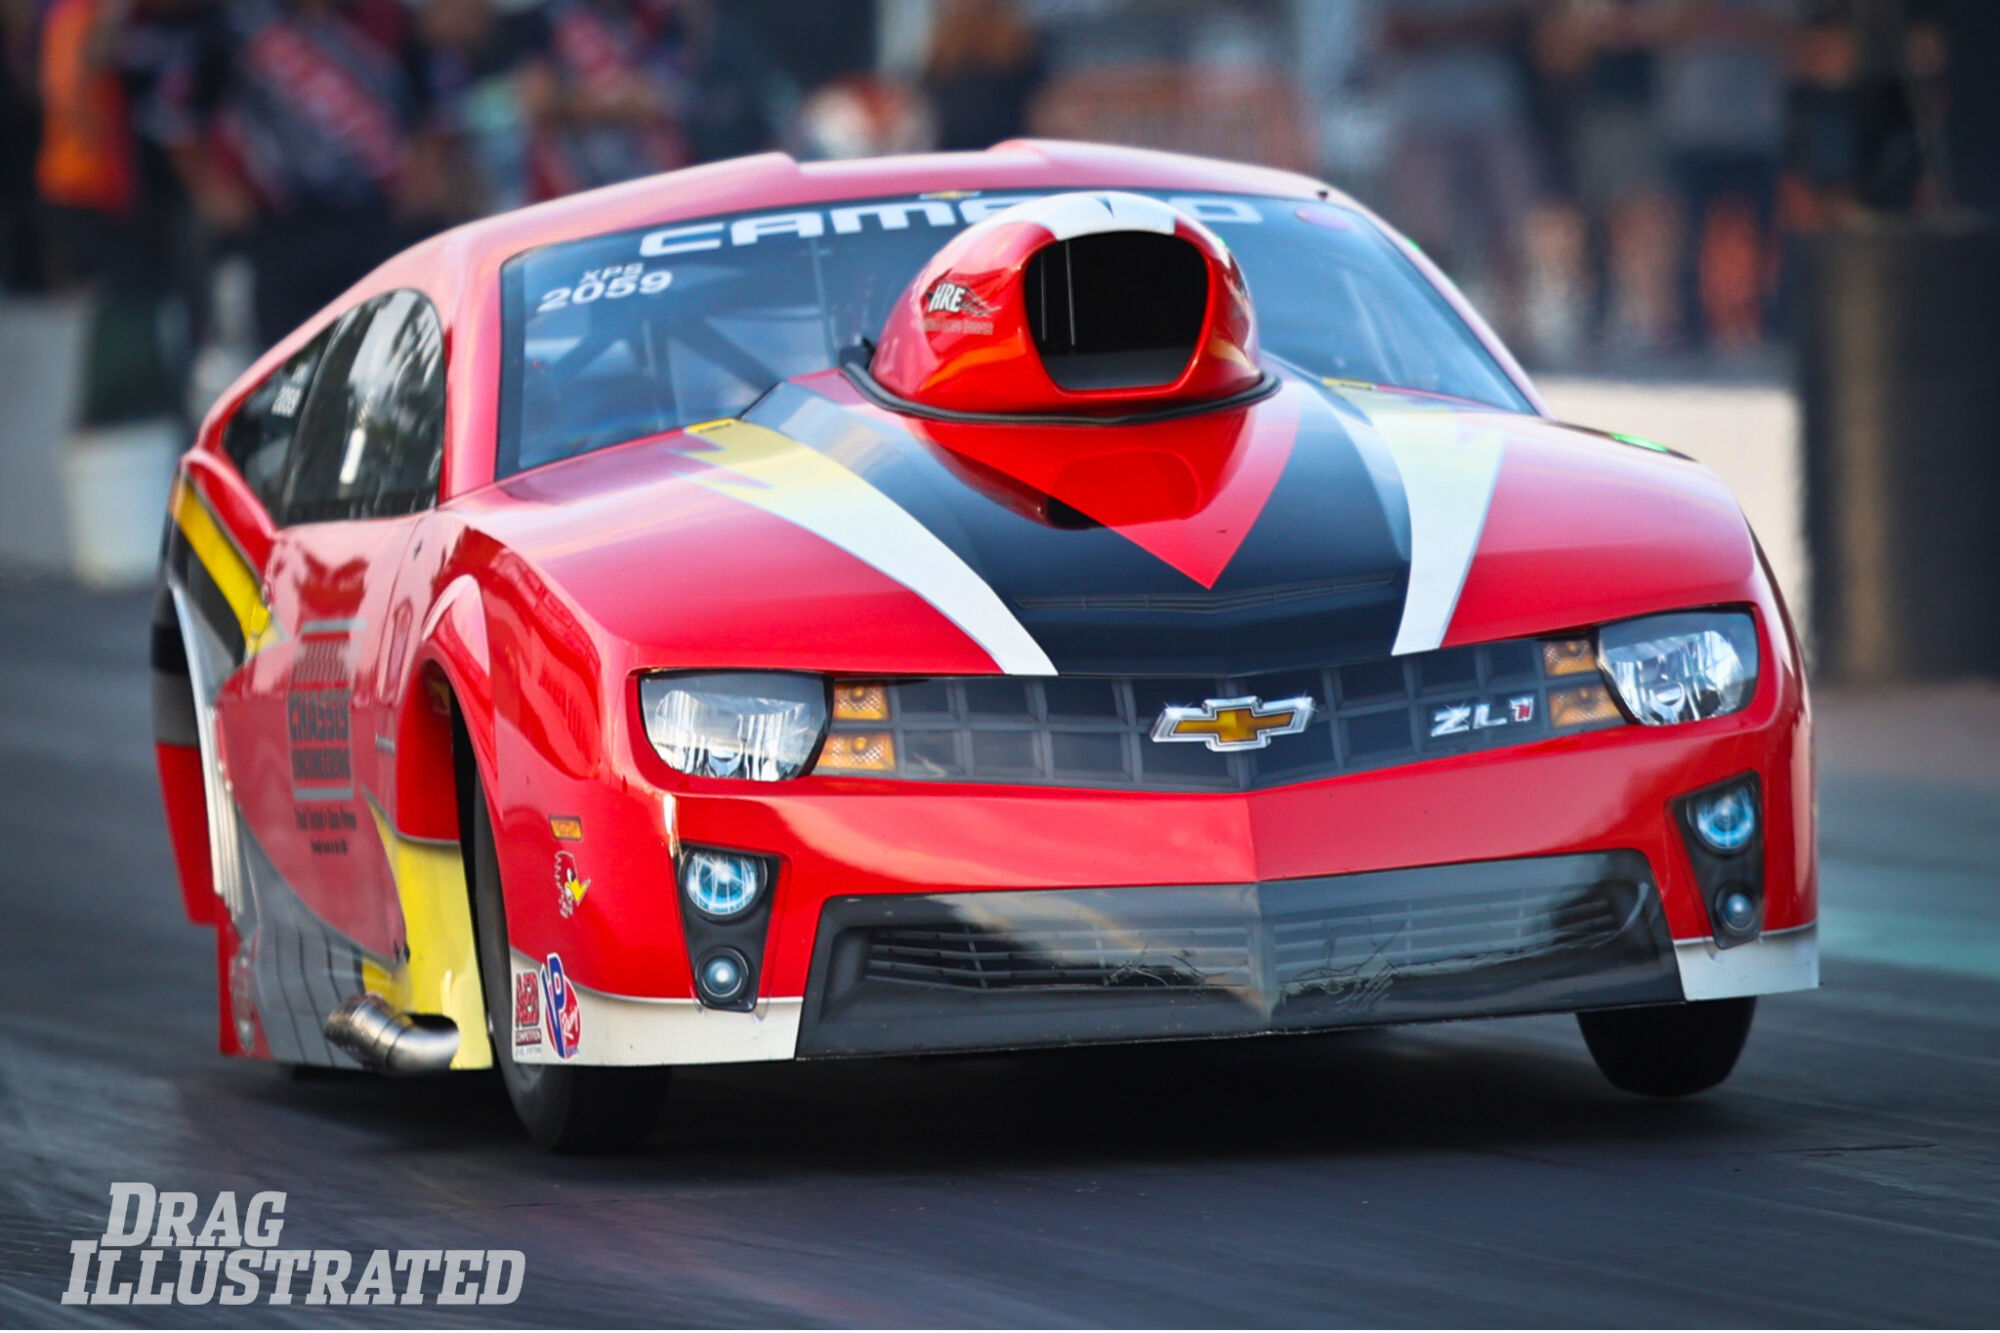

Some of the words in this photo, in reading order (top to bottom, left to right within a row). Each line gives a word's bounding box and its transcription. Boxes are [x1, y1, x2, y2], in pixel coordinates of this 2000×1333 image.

[639, 196, 1263, 257] CAMO
[536, 270, 672, 313] 2059
[928, 283, 966, 312] HRE
[1431, 697, 1534, 737] ZL1
